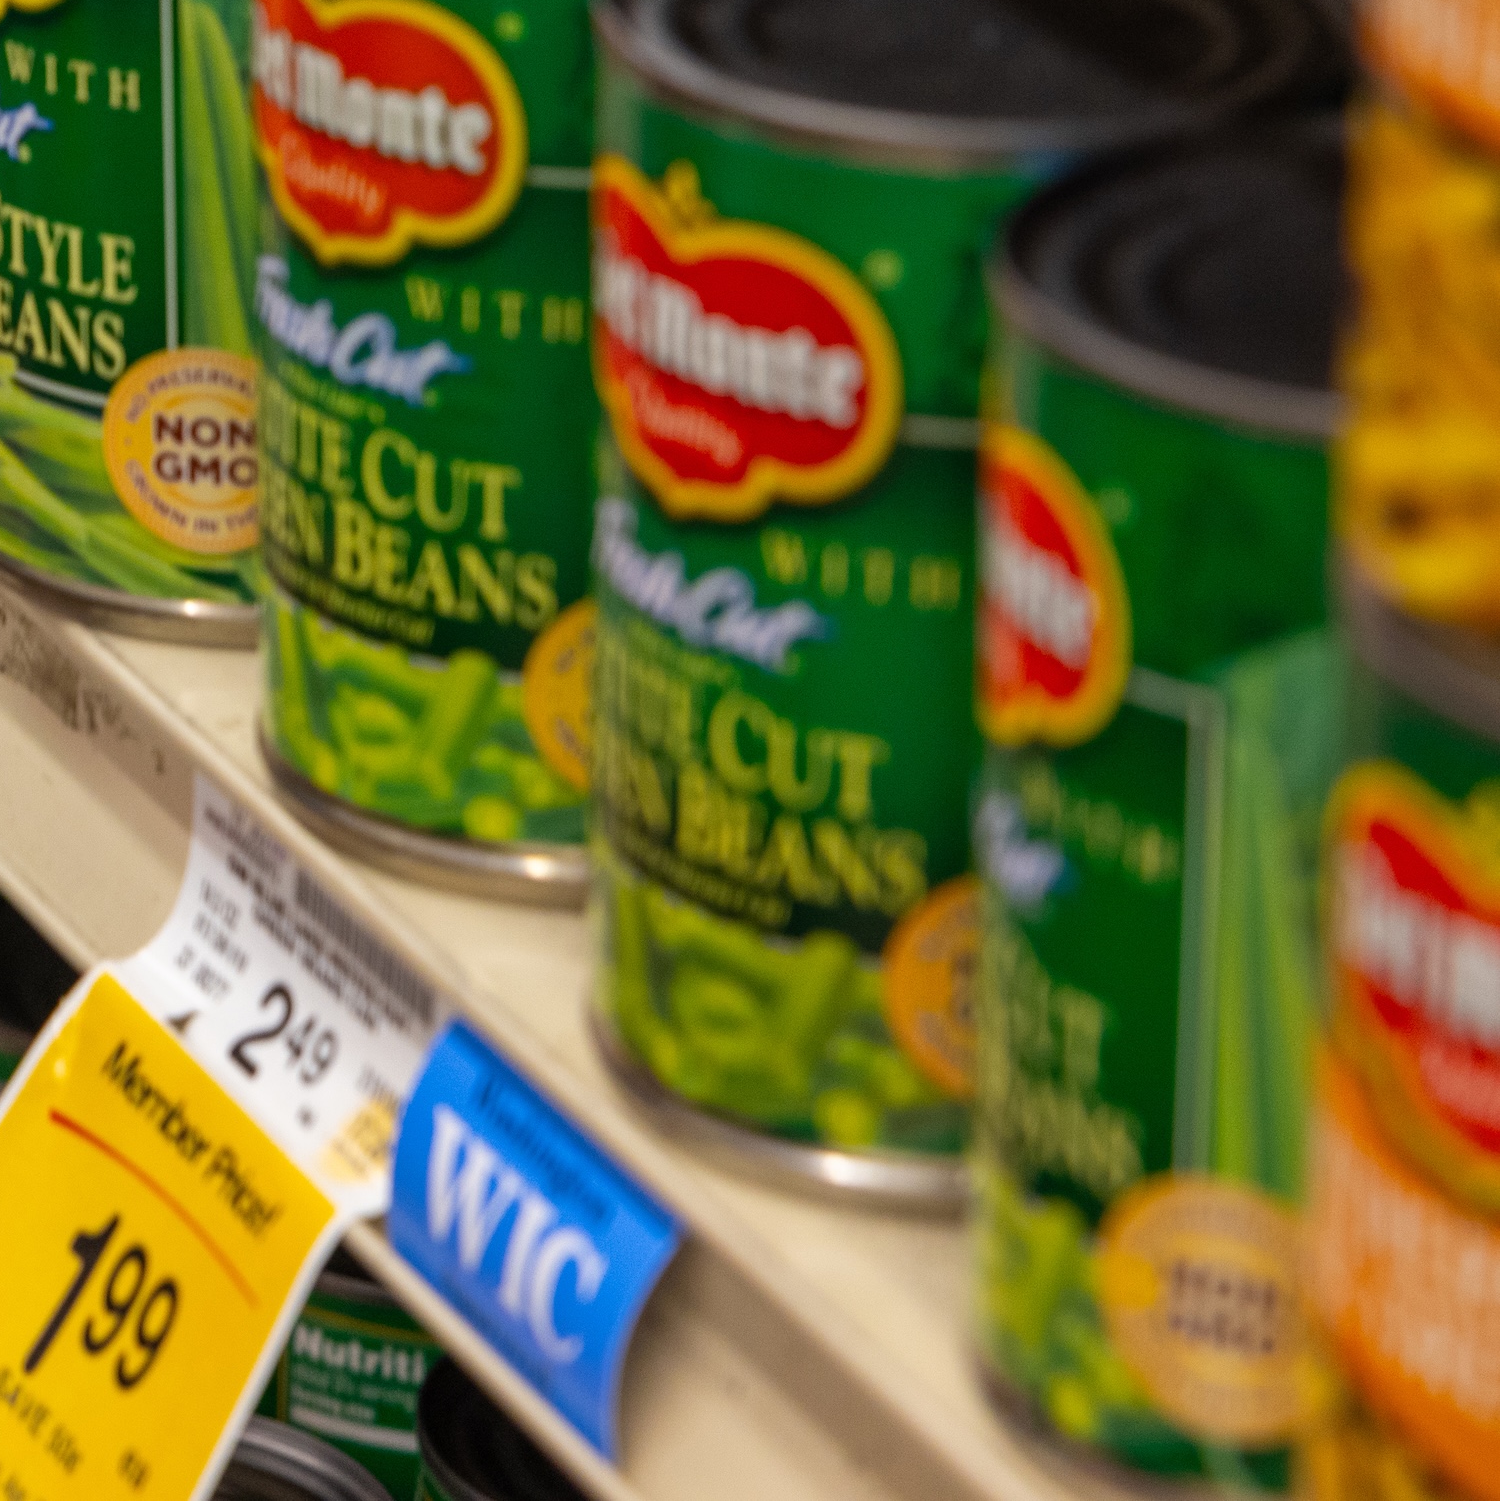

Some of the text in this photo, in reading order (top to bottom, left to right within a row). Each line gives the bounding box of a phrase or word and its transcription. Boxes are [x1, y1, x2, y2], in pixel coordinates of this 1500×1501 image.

[4, 38, 142, 112] WITH
[296, 41, 494, 178] Monte
[404, 273, 585, 345] WITH
[153, 413, 257, 449] NON
[153, 451, 259, 489] GMO
[360, 427, 523, 542] CUT
[331, 497, 559, 631] BEANS
[708, 689, 893, 823] CUT
[227, 981, 341, 1086] 249
[101, 1039, 285, 1240] Member Price!
[425, 1101, 610, 1366] WIC
